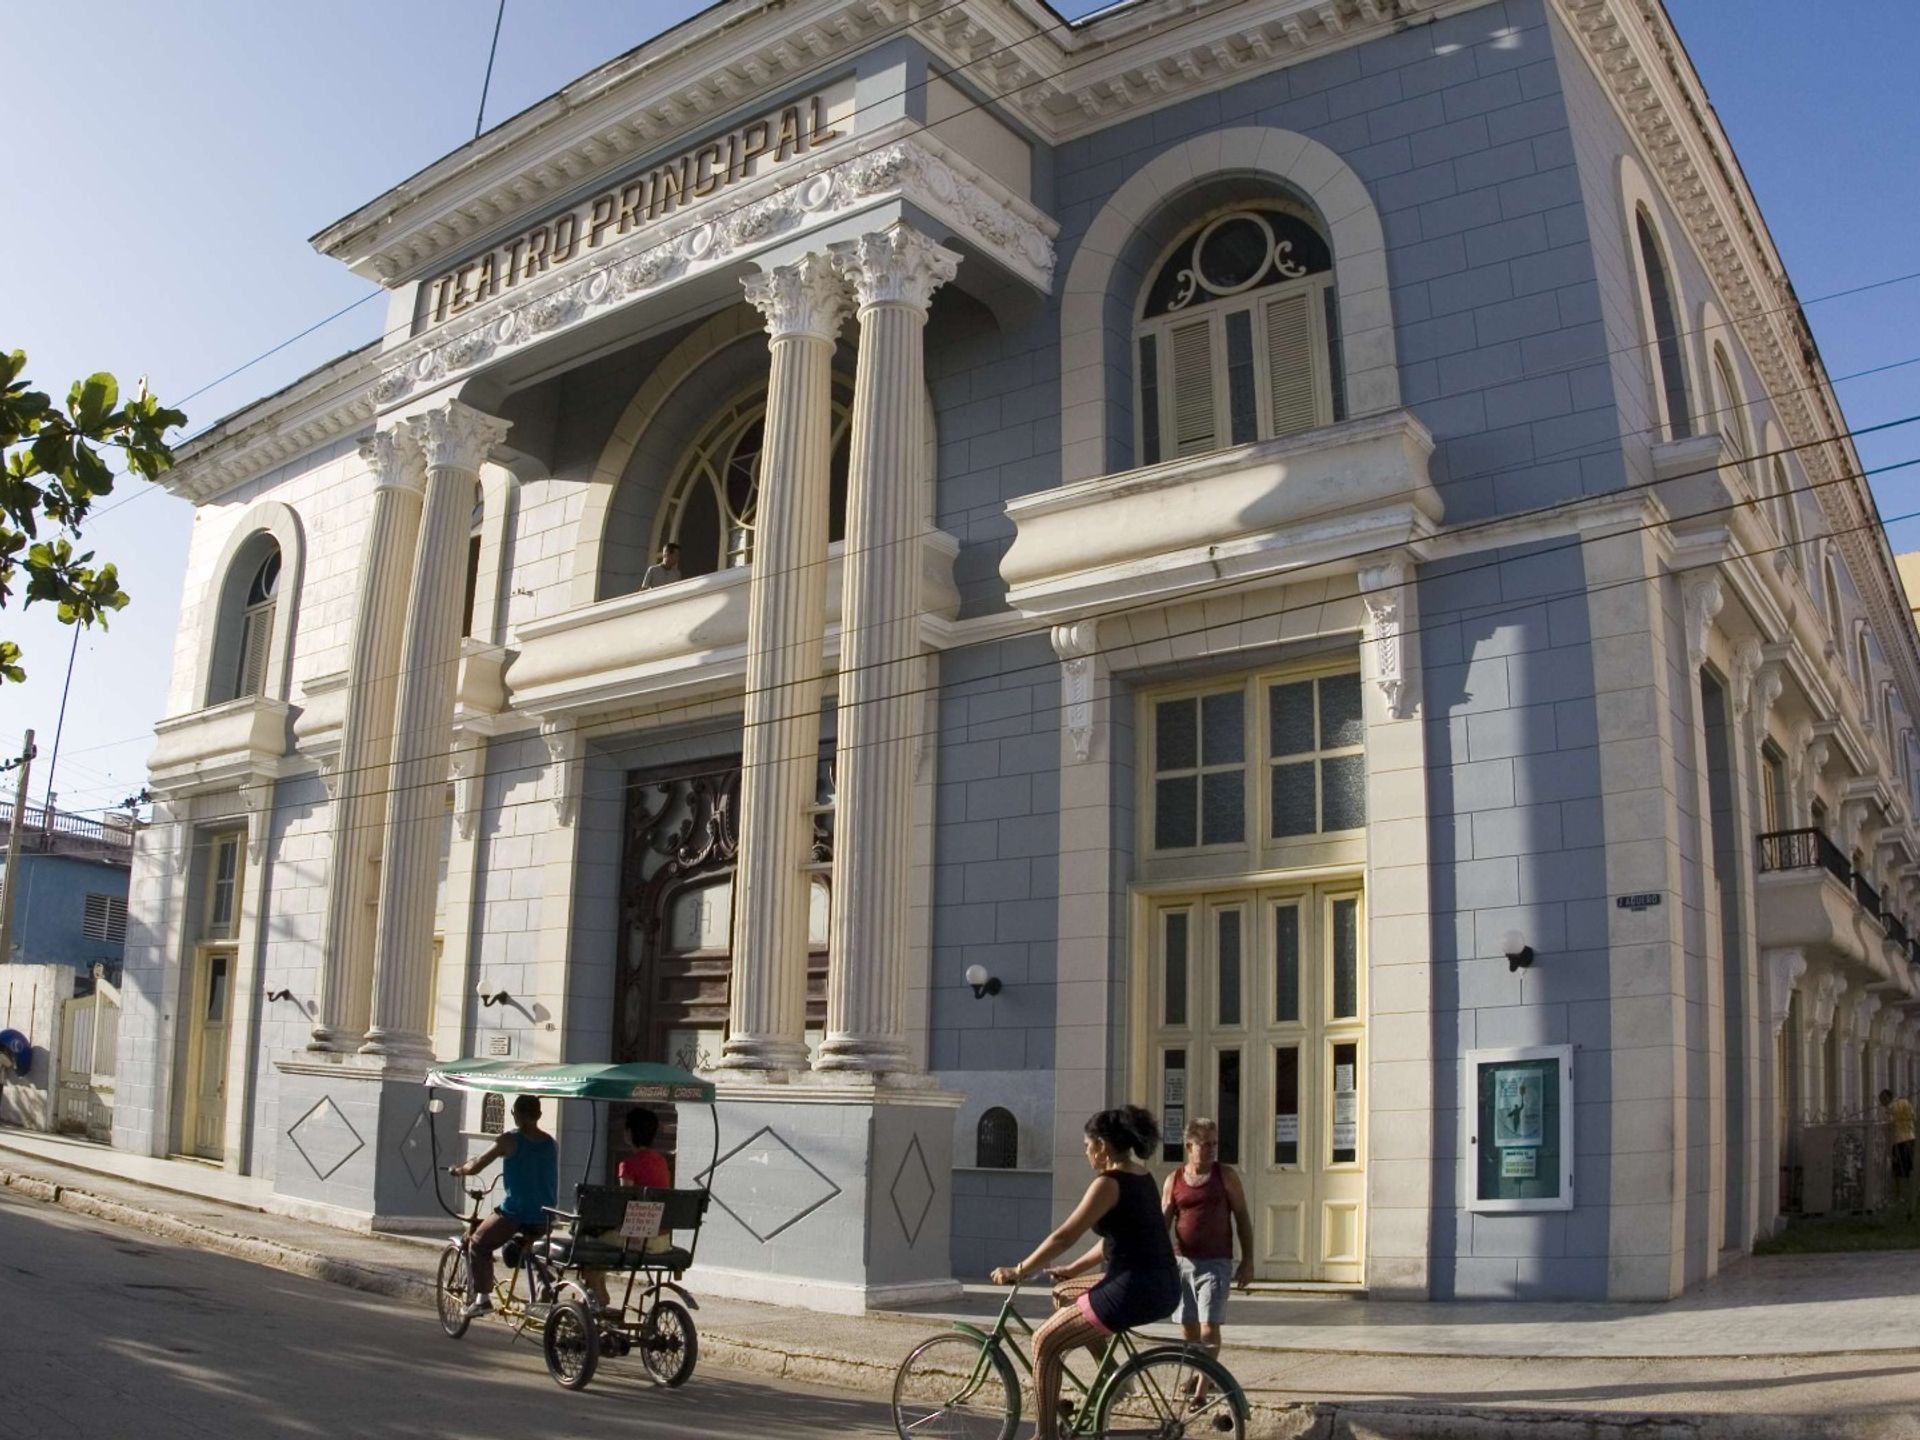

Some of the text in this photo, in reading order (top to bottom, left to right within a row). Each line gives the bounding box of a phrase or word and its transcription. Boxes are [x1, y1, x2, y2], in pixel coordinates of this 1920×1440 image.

[431, 96, 836, 322] TEATRO PRINCIPAL
[632, 1086, 670, 1098] CRISTAL
